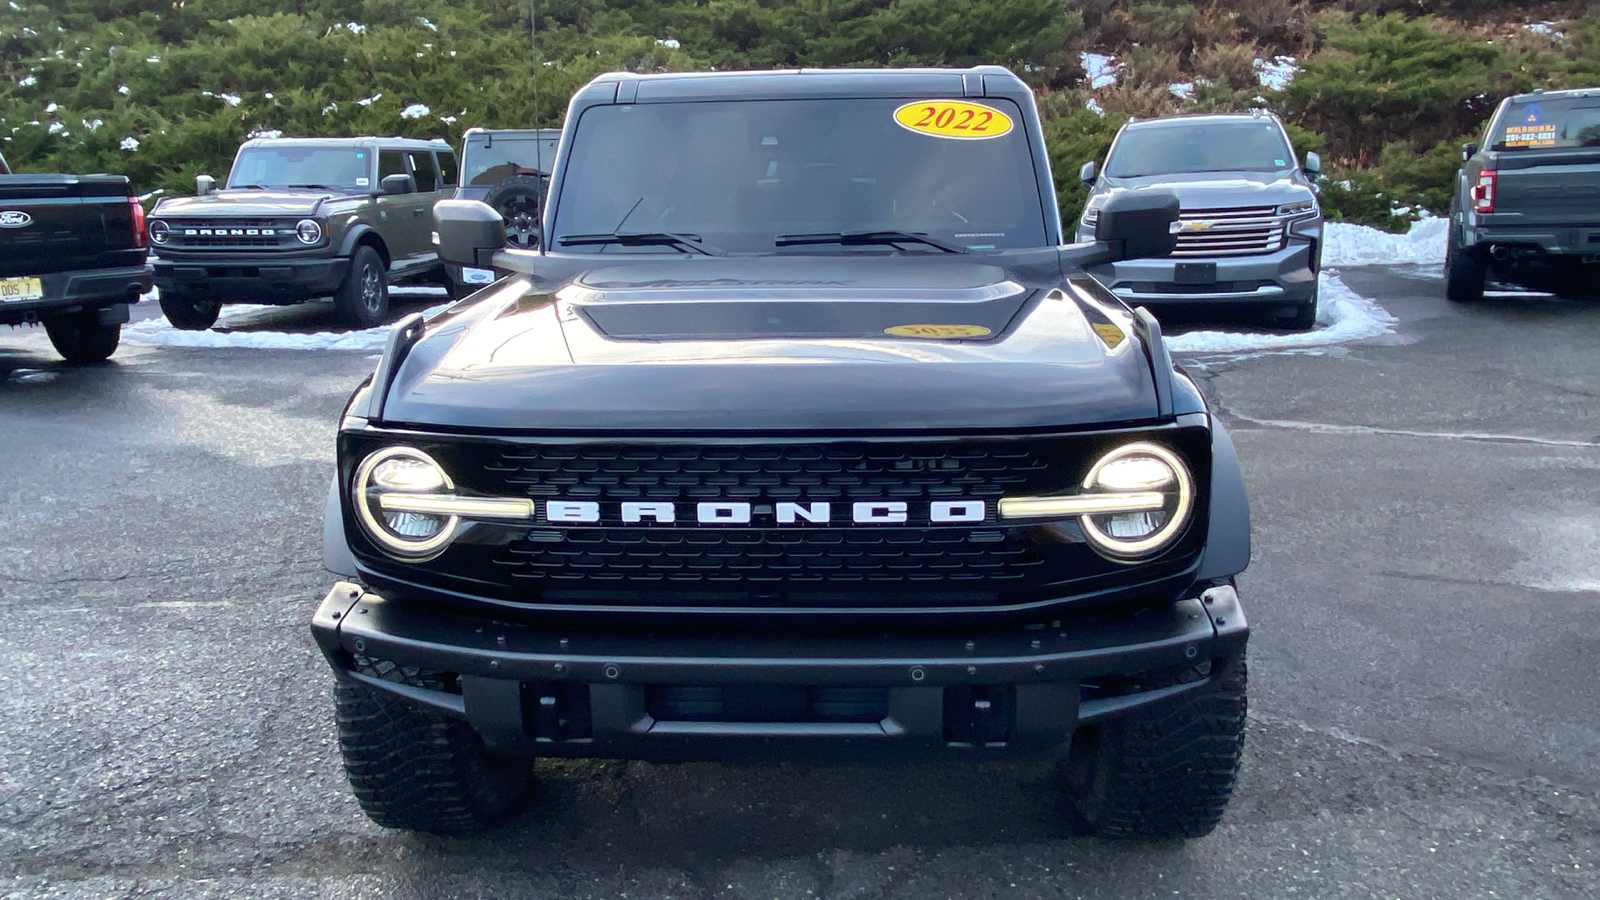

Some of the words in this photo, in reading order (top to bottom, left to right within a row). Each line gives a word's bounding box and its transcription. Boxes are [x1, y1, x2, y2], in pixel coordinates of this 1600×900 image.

[913, 106, 993, 132] 2022
[1, 212, 24, 224] Ford
[546, 501, 985, 523] BRONCO
